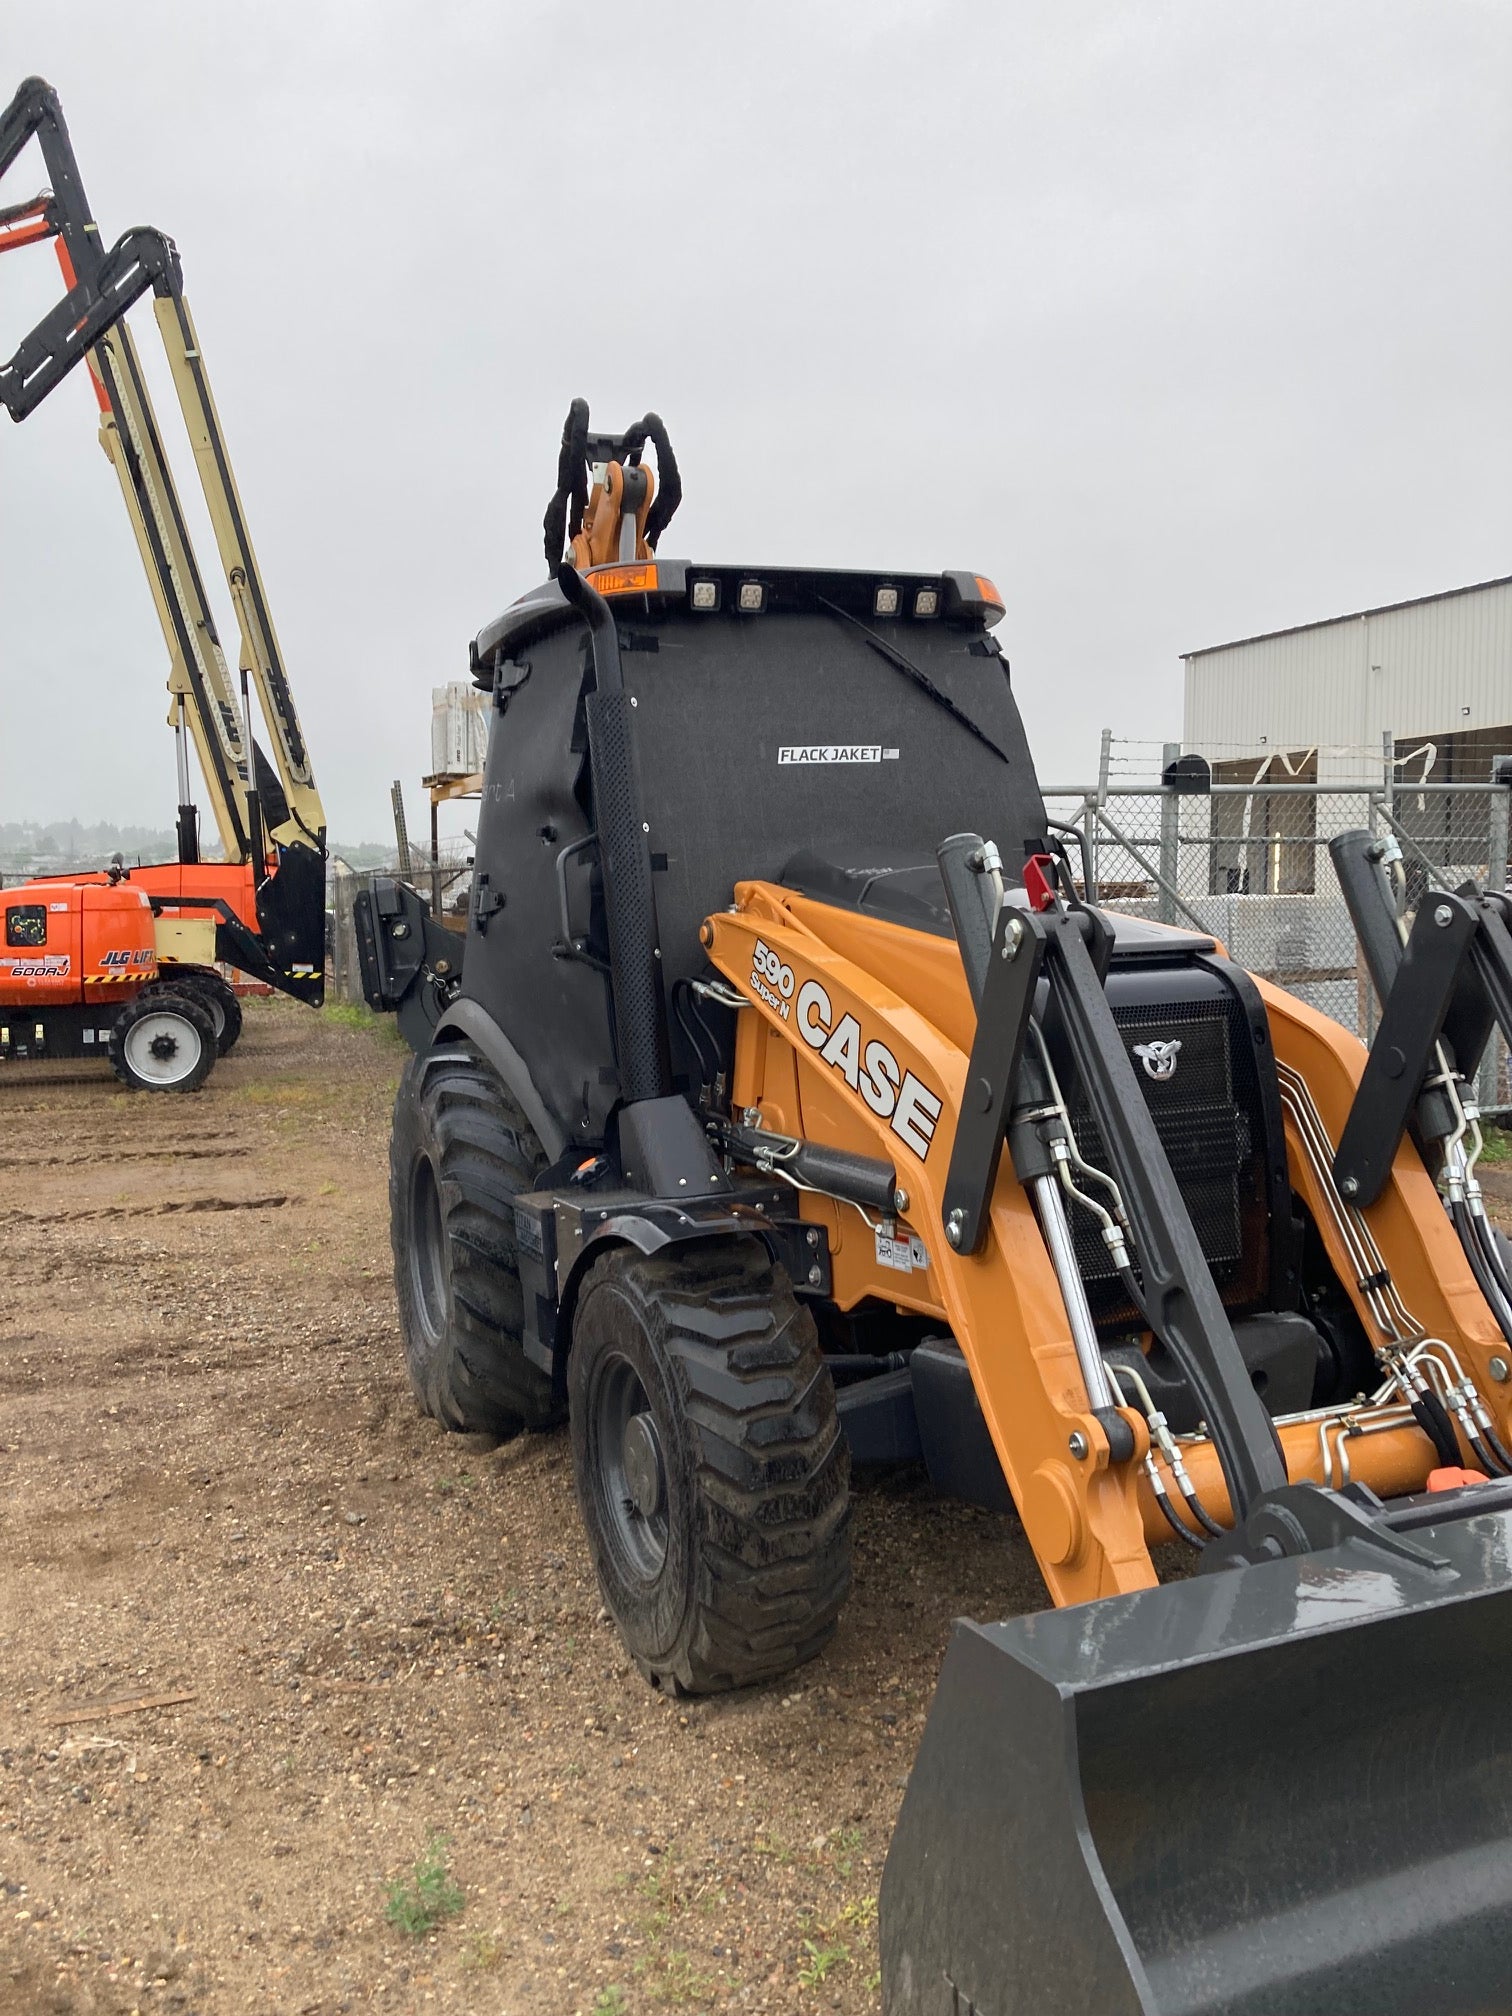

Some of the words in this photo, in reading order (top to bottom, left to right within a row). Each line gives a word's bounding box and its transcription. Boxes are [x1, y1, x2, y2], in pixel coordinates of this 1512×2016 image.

[780, 749, 828, 762] FLACK
[831, 748, 880, 760] JAKET
[11, 967, 70, 977] 600AJ
[99, 950, 131, 966] JLG
[753, 938, 795, 999] 590
[750, 970, 780, 1010] Super
[779, 999, 790, 1021] N
[796, 978, 944, 1164] CASE
